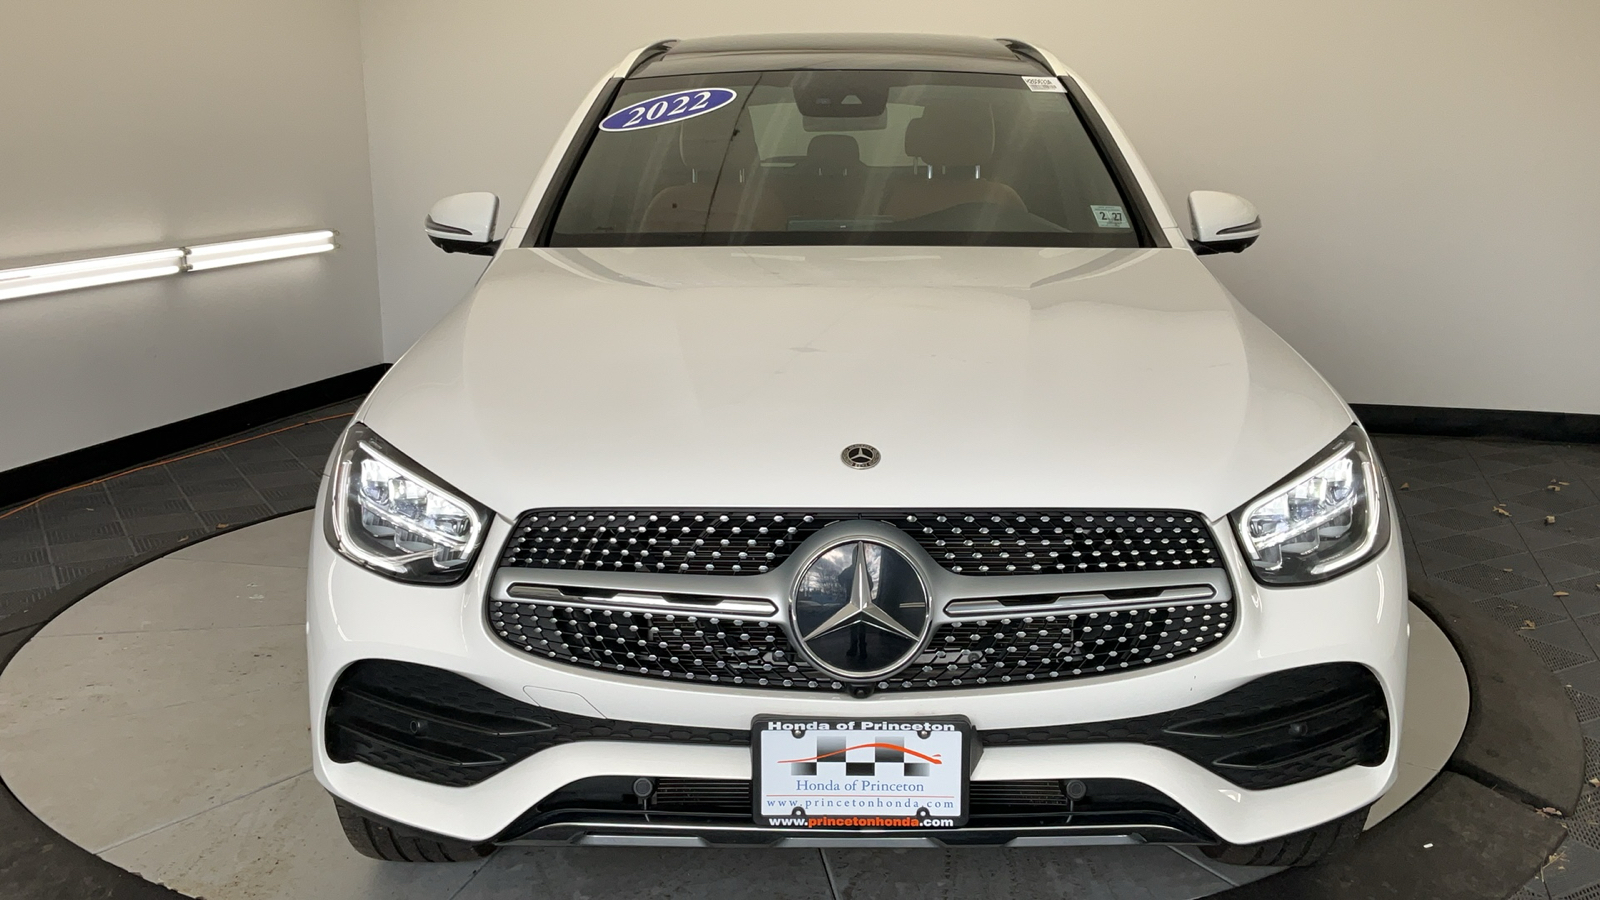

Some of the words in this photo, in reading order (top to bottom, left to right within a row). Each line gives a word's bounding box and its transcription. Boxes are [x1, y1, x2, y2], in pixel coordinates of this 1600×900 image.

[622, 91, 711, 128] 2022
[1100, 212, 1108, 220] 2
[1112, 212, 1122, 222] 27
[768, 721, 830, 731] Honda
[836, 721, 855, 731] of
[861, 721, 955, 732] Princeton
[796, 780, 840, 792] Honda
[844, 780, 858, 791] of
[862, 780, 924, 792] Princeton
[766, 798, 954, 809] www.princetonhonda.com
[769, 817, 954, 828] www.princetonhonda.com
